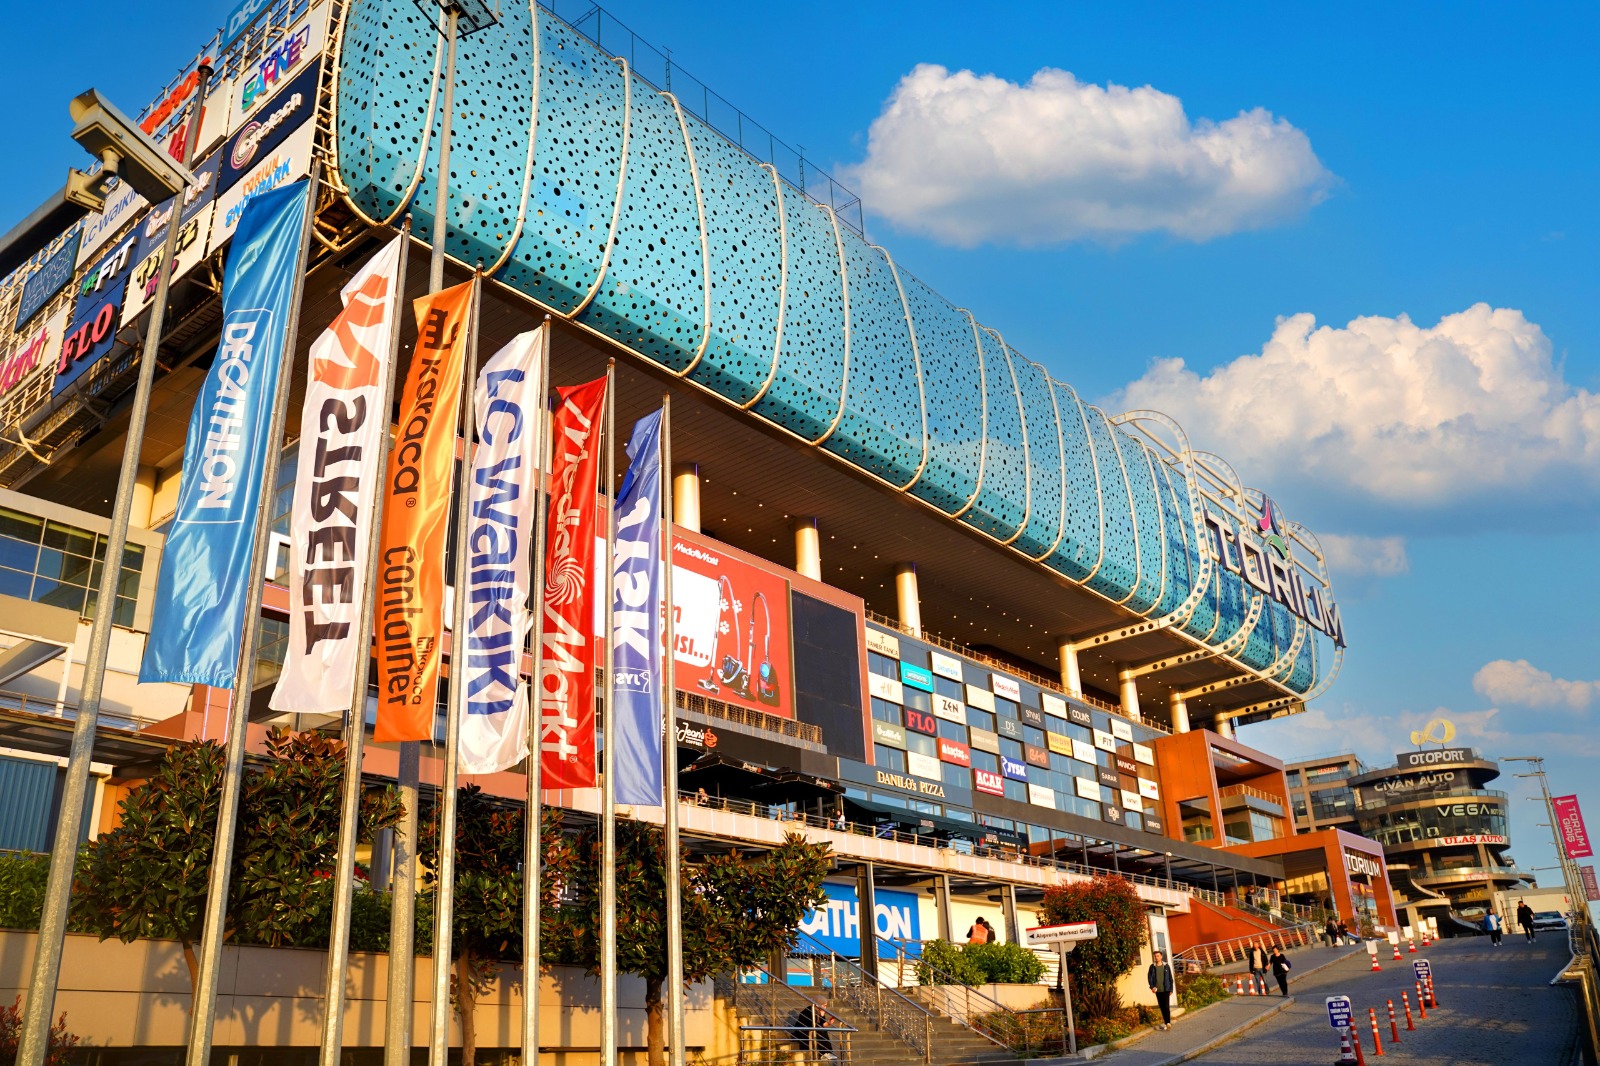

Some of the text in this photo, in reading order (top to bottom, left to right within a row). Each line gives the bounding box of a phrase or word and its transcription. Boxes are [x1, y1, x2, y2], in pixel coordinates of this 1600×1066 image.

[242, 36, 302, 110] SAHNE
[57, 303, 113, 375] FLO
[197, 321, 255, 509] DECATHLON
[482, 368, 525, 448] LC
[393, 358, 441, 495] karaca
[1203, 509, 1346, 648] TORIUM
[384, 546, 423, 705] container
[906, 709, 936, 734] FLO
[942, 699, 959, 713] ZEN
[1007, 761, 1027, 777] JYSK
[1409, 750, 1465, 765] OTOPORT
[919, 780, 945, 798] PIZZA
[976, 771, 1003, 790] ACAR
[1420, 771, 1455, 786] AUTO
[1480, 835, 1504, 843] AUTO
[1568, 806, 1586, 847] TORIUM
[1344, 853, 1381, 878] TORIUM
[797, 898, 912, 942] CATHON
